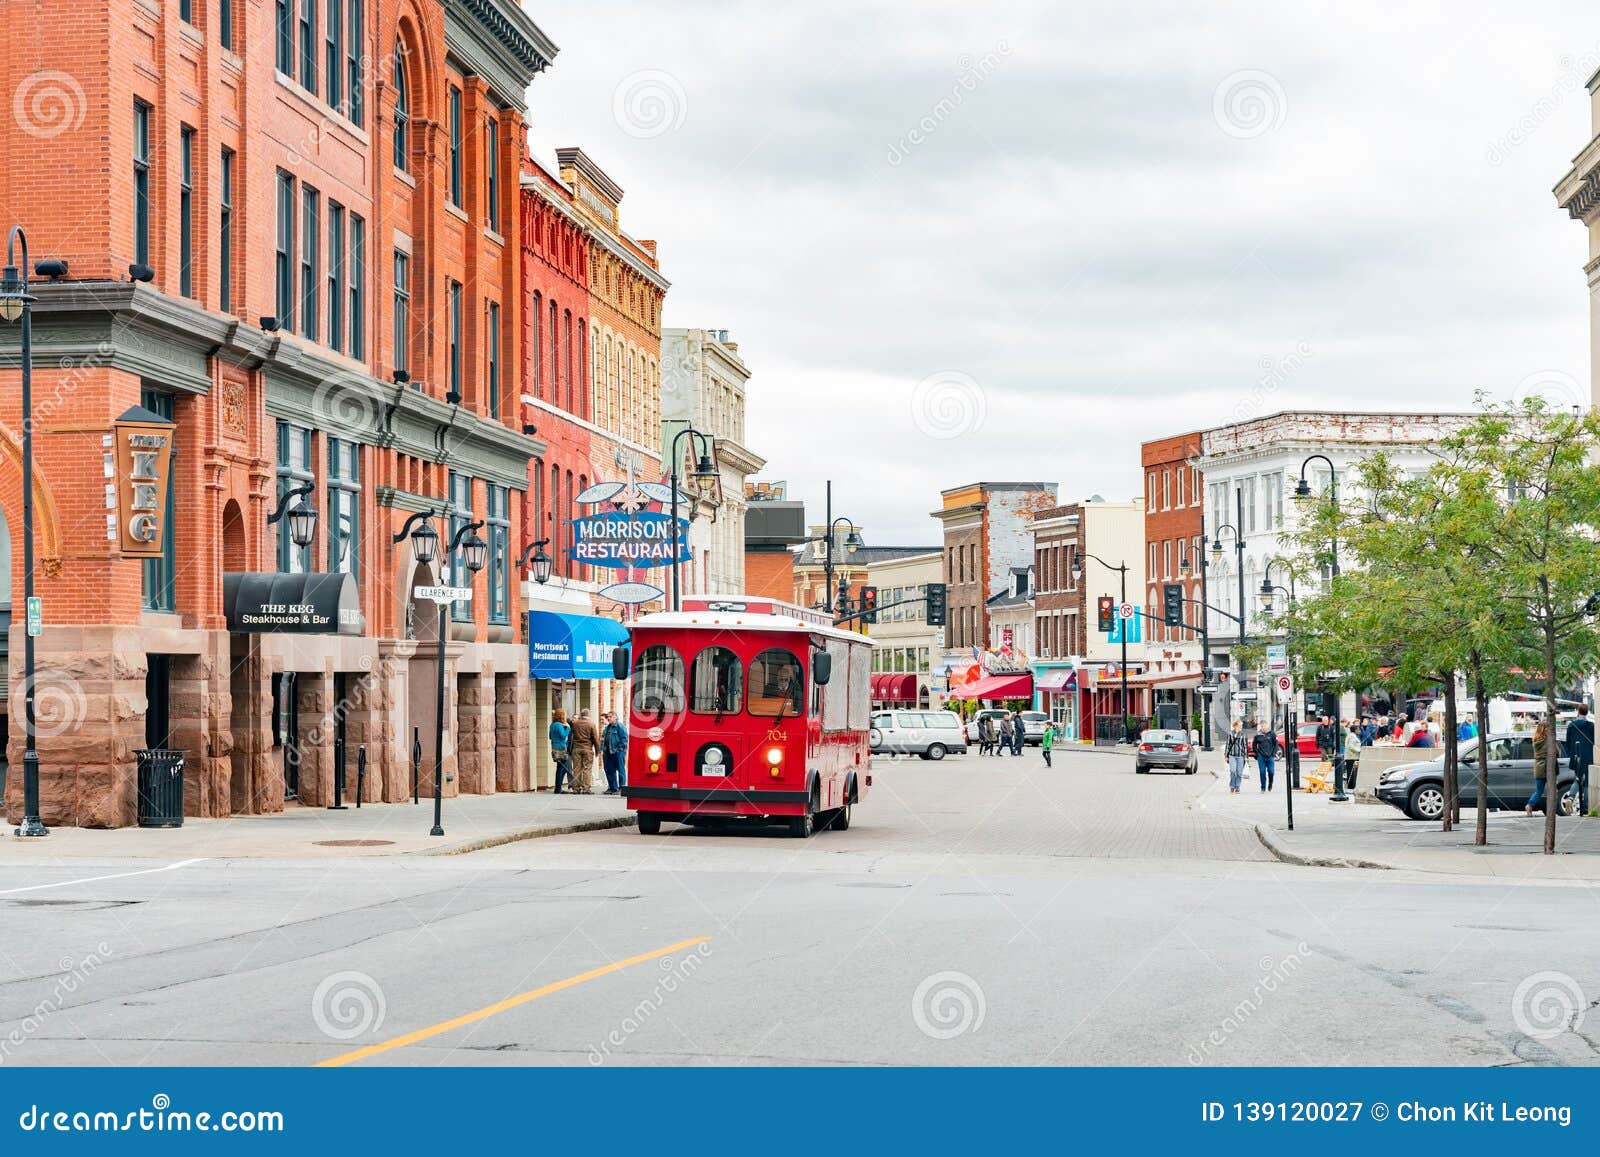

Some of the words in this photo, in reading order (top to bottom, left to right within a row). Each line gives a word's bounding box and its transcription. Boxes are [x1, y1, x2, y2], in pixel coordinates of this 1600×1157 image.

[576, 543, 685, 559] RESTAURANT
[420, 588, 454, 598] CLARENCE
[458, 589, 467, 598] ST
[260, 604, 286, 614] THE
[287, 604, 315, 614] KEG
[242, 614, 300, 624] Steakhouse
[302, 614, 310, 624] &
[312, 614, 330, 624] Bar
[534, 642, 569, 652] Morrison's
[533, 651, 570, 661] Restaurant
[767, 729, 788, 741] 704
